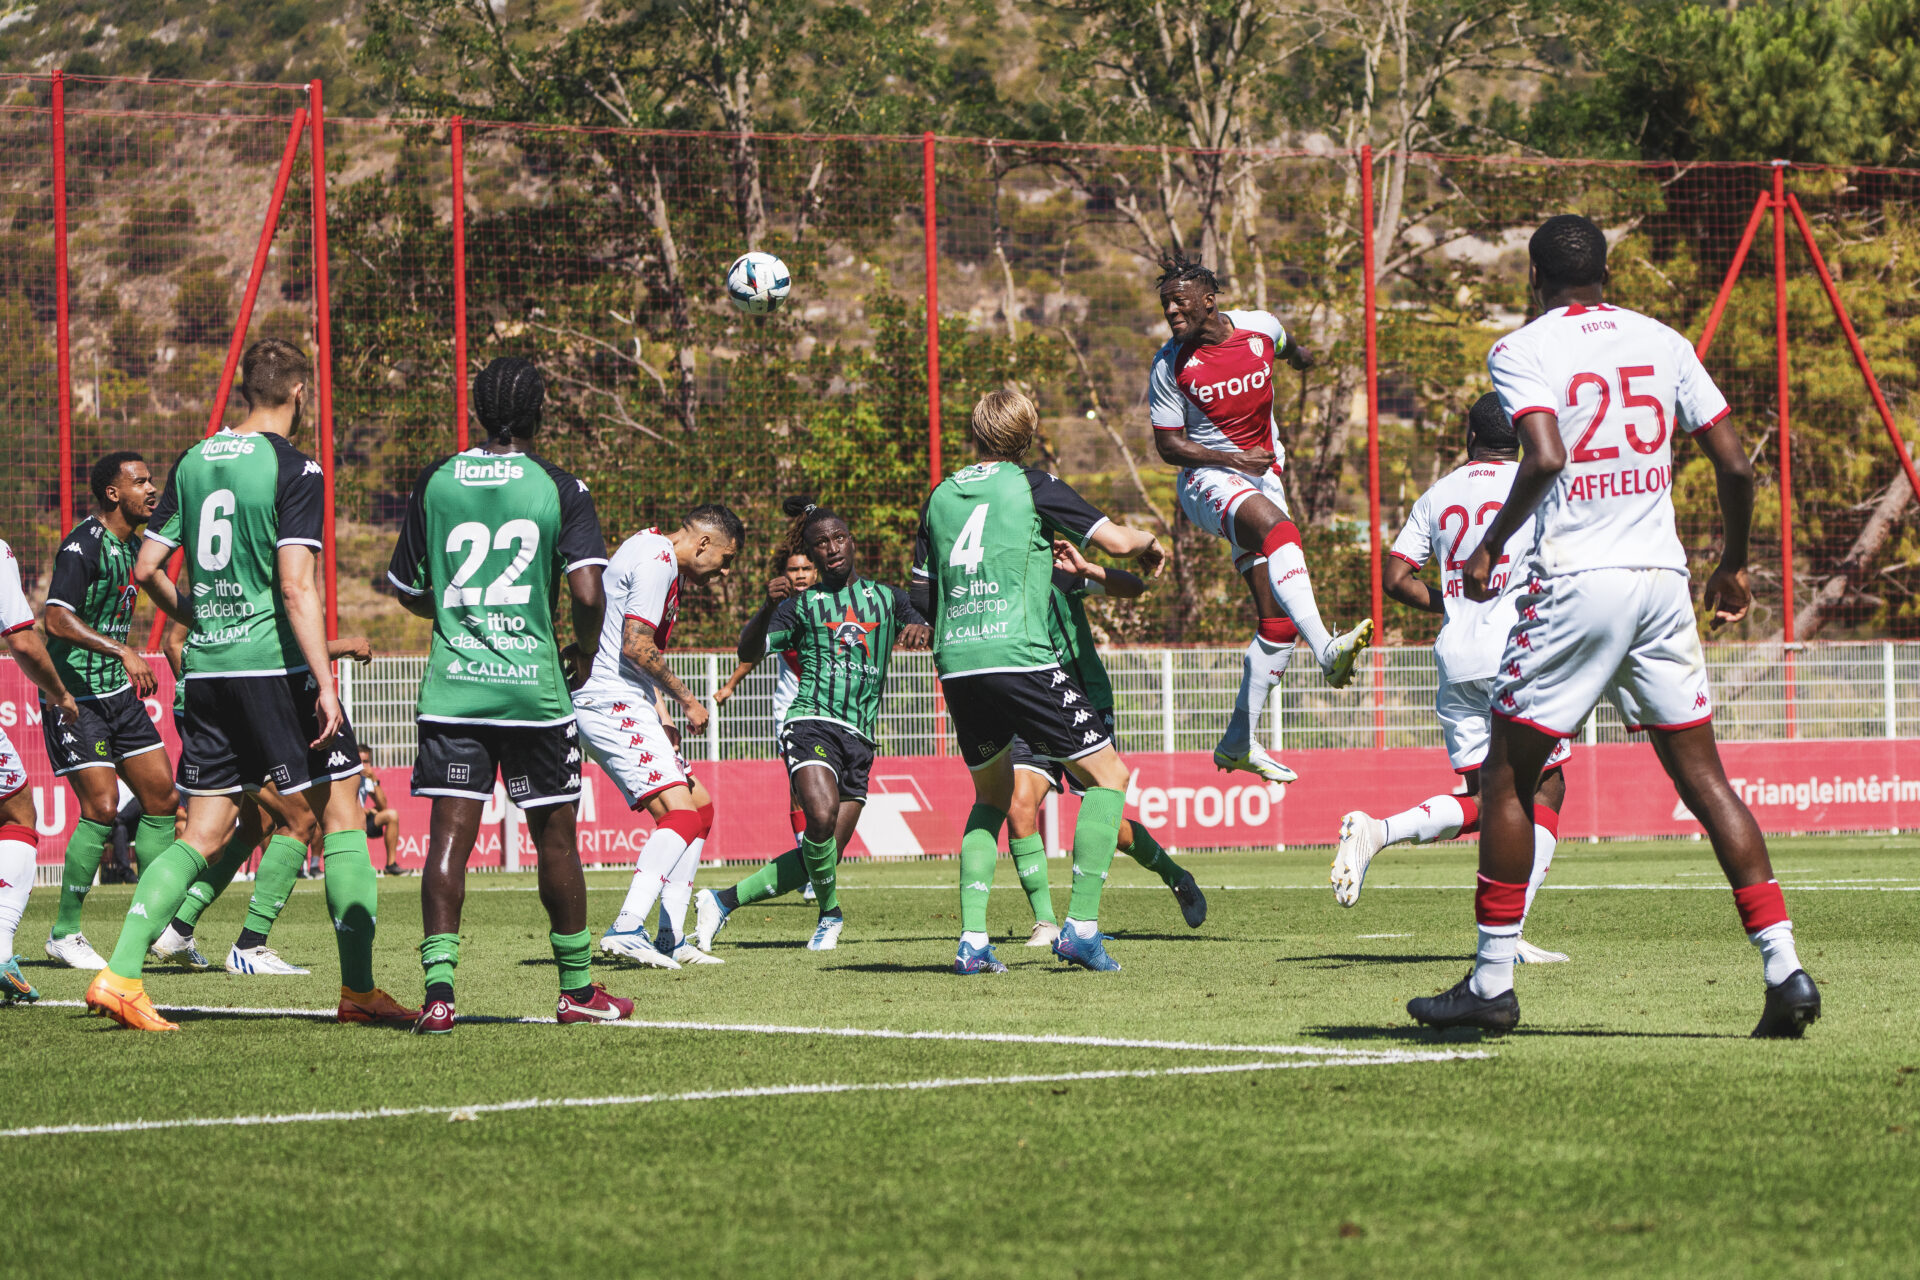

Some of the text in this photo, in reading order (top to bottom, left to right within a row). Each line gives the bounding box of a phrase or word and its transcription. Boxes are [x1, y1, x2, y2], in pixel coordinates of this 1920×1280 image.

[1565, 365, 1667, 463] 25
[200, 439, 256, 456] liantis
[454, 460, 524, 480] liantis
[1468, 470, 1496, 479] FEDCOM
[1567, 464, 1671, 501] AFFLELOU
[197, 489, 235, 571] 6
[949, 503, 990, 575] 4
[443, 519, 540, 608] 22
[215, 579, 243, 597] itho
[970, 579, 999, 596] itho
[193, 600, 255, 619] aalderop
[487, 612, 526, 631] itho
[955, 622, 1009, 638] CALLANT
[467, 661, 539, 678] CALLANT
